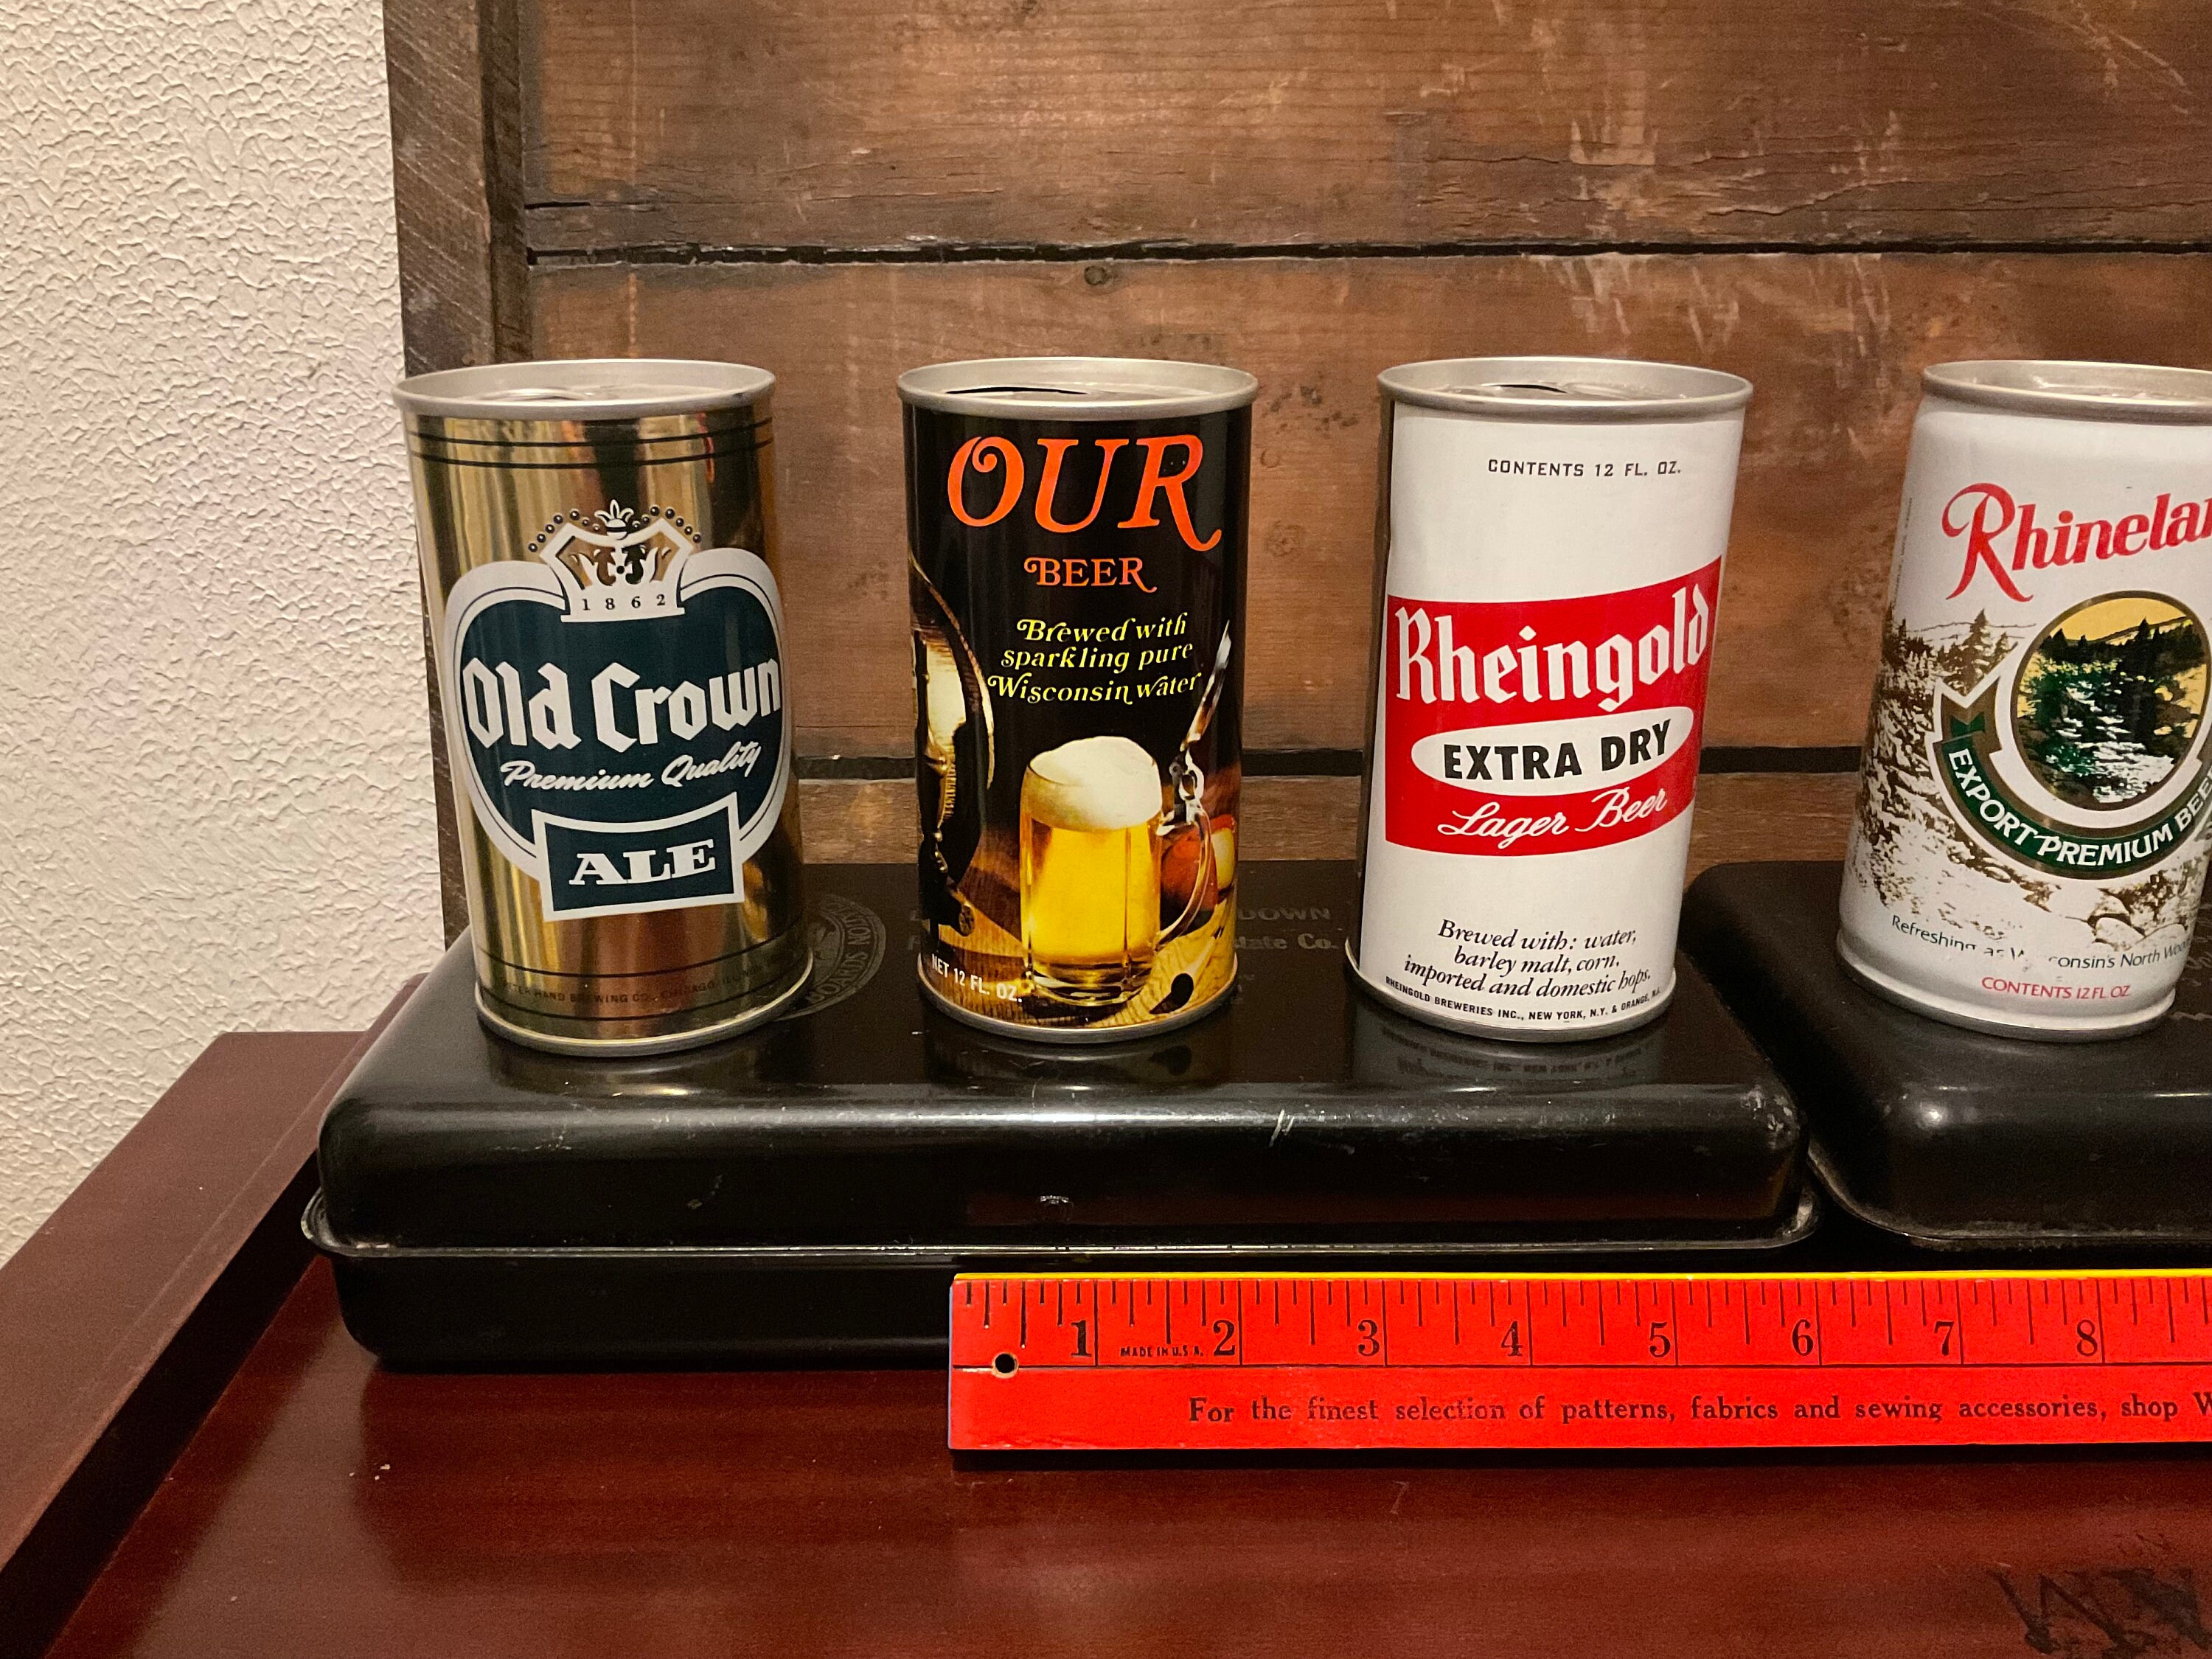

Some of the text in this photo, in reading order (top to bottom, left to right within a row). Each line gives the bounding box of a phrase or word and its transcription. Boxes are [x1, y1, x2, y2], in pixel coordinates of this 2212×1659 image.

[1487, 458, 1682, 477] CONTENTS 12 FL. OZ.
[947, 434, 1222, 552] OUR
[1941, 482, 2212, 602] Rhinela
[1023, 557, 1158, 593] BEER
[1016, 613, 1189, 642] Brewed with
[1394, 582, 1709, 712] Rheingold
[1001, 642, 1194, 674] sparkling pure
[462, 658, 781, 753] Old Crown
[987, 672, 1203, 705] Wisconsin water
[500, 741, 762, 791] Premium Quality
[1442, 718, 1672, 782] EXTRA DRY
[1437, 786, 1669, 849] Lager Beer
[1948, 748, 2039, 846] EXPORT
[2034, 823, 2174, 866] PREMIUM
[568, 839, 717, 886] ALE
[1438, 919, 1637, 950] Brewed with: water,
[931, 953, 1023, 1004] NET 12 FL. OZ.
[1403, 954, 1652, 998] imported and domestic hops.
[1453, 945, 1517, 978] barley
[1520, 954, 1572, 975] malt,
[2119, 949, 2160, 968] North
[1385, 975, 1430, 1003] RHEINGOLD
[1433, 996, 1494, 1017] BREWERIES
[1498, 1009, 1525, 1021] INC.,
[1528, 1011, 1553, 1020] NEW
[1557, 1010, 1587, 1020] YORK,
[1611, 1005, 1618, 1014] &
[1621, 992, 1651, 1011] ORANGE,
[1981, 976, 2072, 1001] CONTENTS
[2076, 987, 2090, 1000] 12
[2110, 985, 2131, 998] OZ
[1071, 1318, 2100, 1359] 1 2 3 4 5 6 7 8
[1120, 1346, 1153, 1357] MADE
[1156, 1346, 1169, 1357] IN
[1189, 1396, 1235, 1423] For
[1251, 1394, 1292, 1420] the
[1307, 1395, 1379, 1421] finest
[1395, 1395, 1506, 1421] selection
[1519, 1395, 1545, 1419] of
[1561, 1399, 1676, 1425] patterns,
[1691, 1395, 1779, 1420] fabrics
[1793, 1394, 1841, 1419] and
[1855, 1394, 1943, 1423] sewing
[1958, 1393, 2107, 1422] accessories,
[2121, 1392, 2178, 1422] shop
